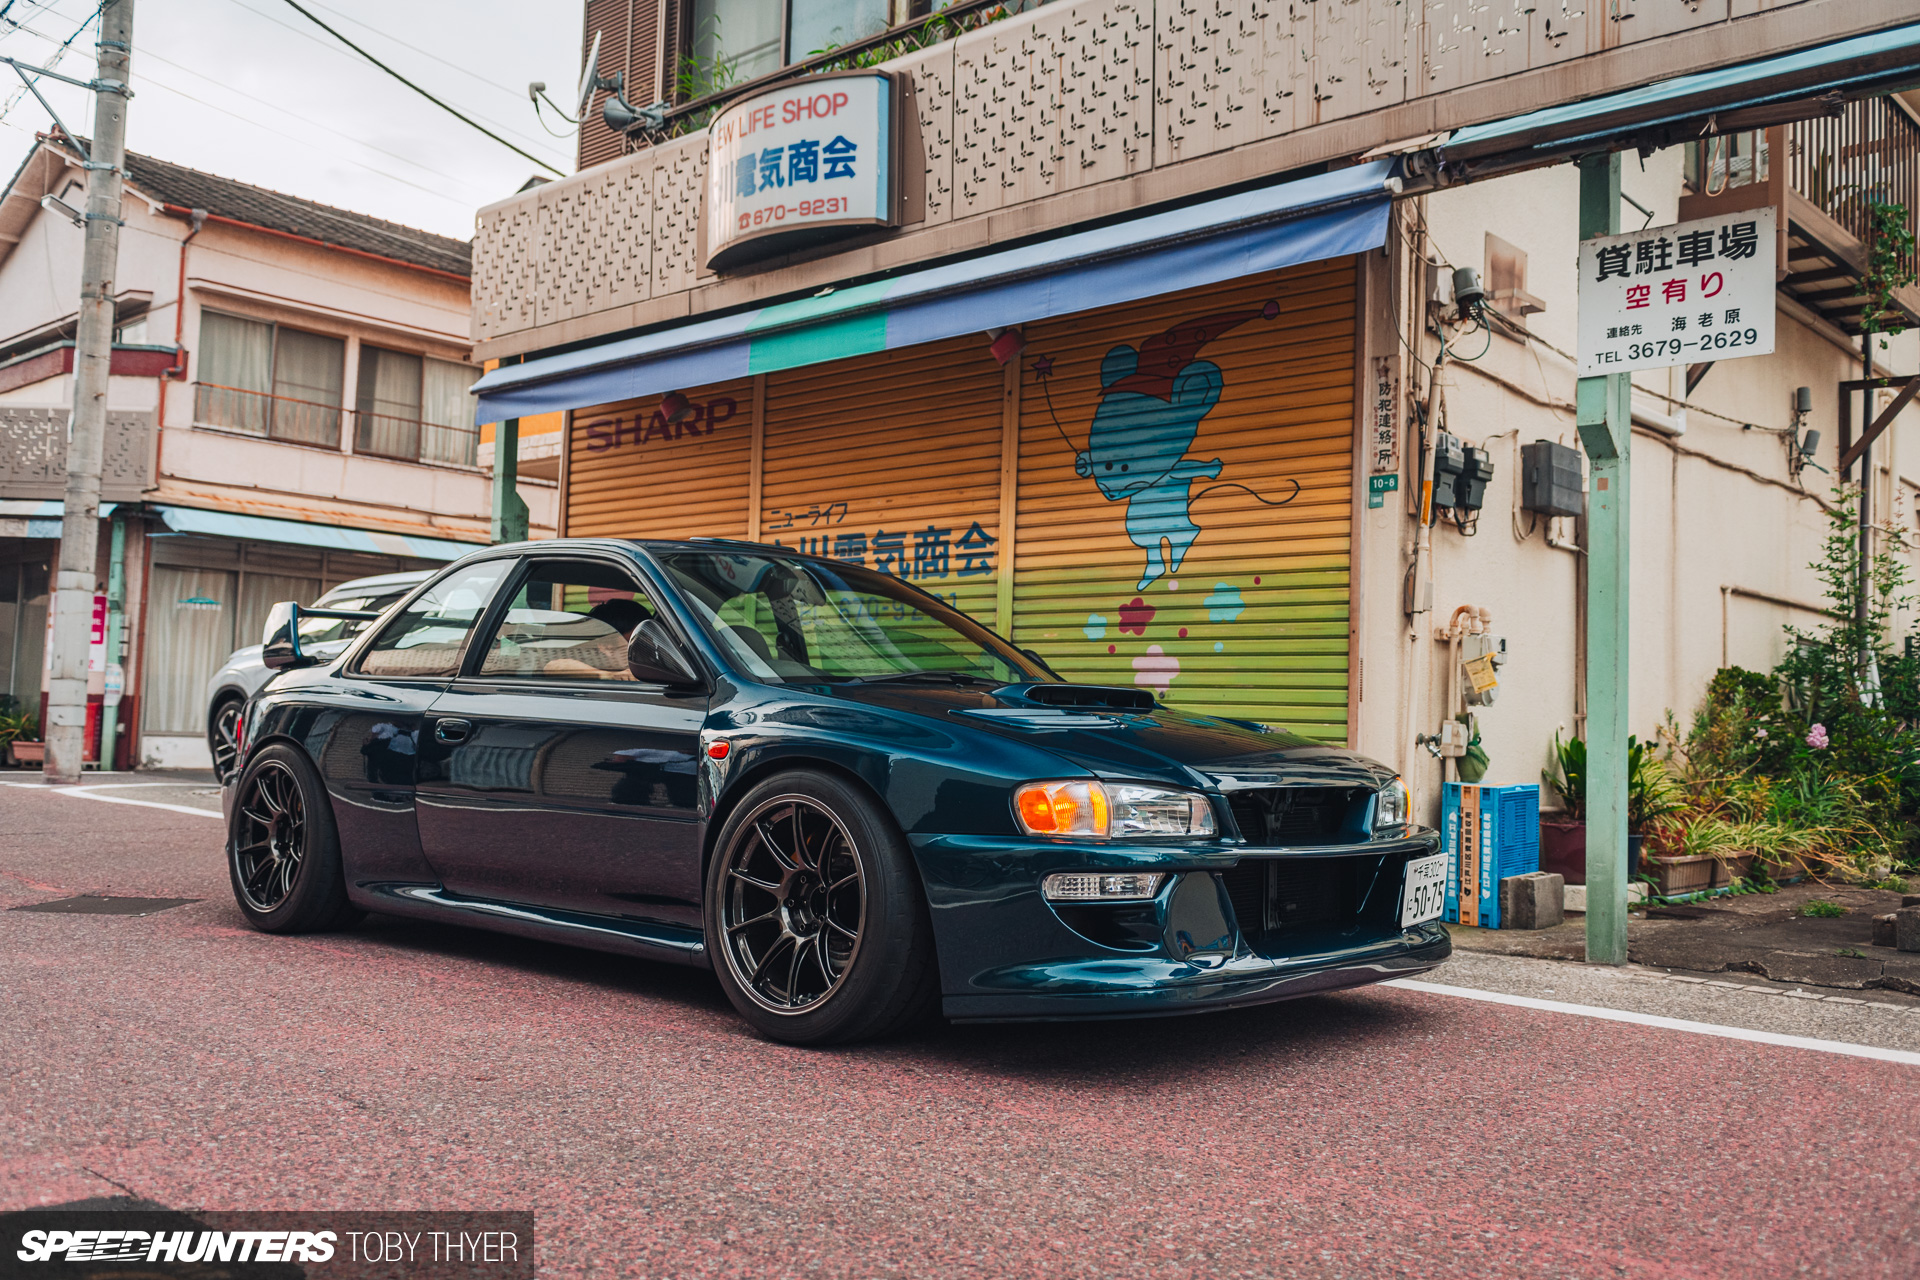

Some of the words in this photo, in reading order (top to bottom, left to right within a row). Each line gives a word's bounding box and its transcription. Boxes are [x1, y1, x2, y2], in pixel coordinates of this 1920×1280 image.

[715, 120, 734, 152] EW
[739, 104, 776, 138] LIFE
[782, 92, 849, 124] SHOP
[716, 135, 858, 206] 川電気商会
[753, 197, 848, 225] 670-9231
[1595, 220, 1758, 283] 貸駐車場
[1626, 271, 1724, 310] 空有り
[1606, 324, 1643, 339] 連絡先
[1671, 308, 1741, 332] 海老原
[1595, 351, 1623, 364] TEL
[1628, 328, 1758, 360] 3679-2629
[586, 397, 737, 453] SHARP
[1378, 382, 1392, 465] 防犯連絡所
[1373, 477, 1395, 489] 10-8
[769, 502, 848, 529] ニューライフ
[1413, 880, 1444, 919] 50-75
